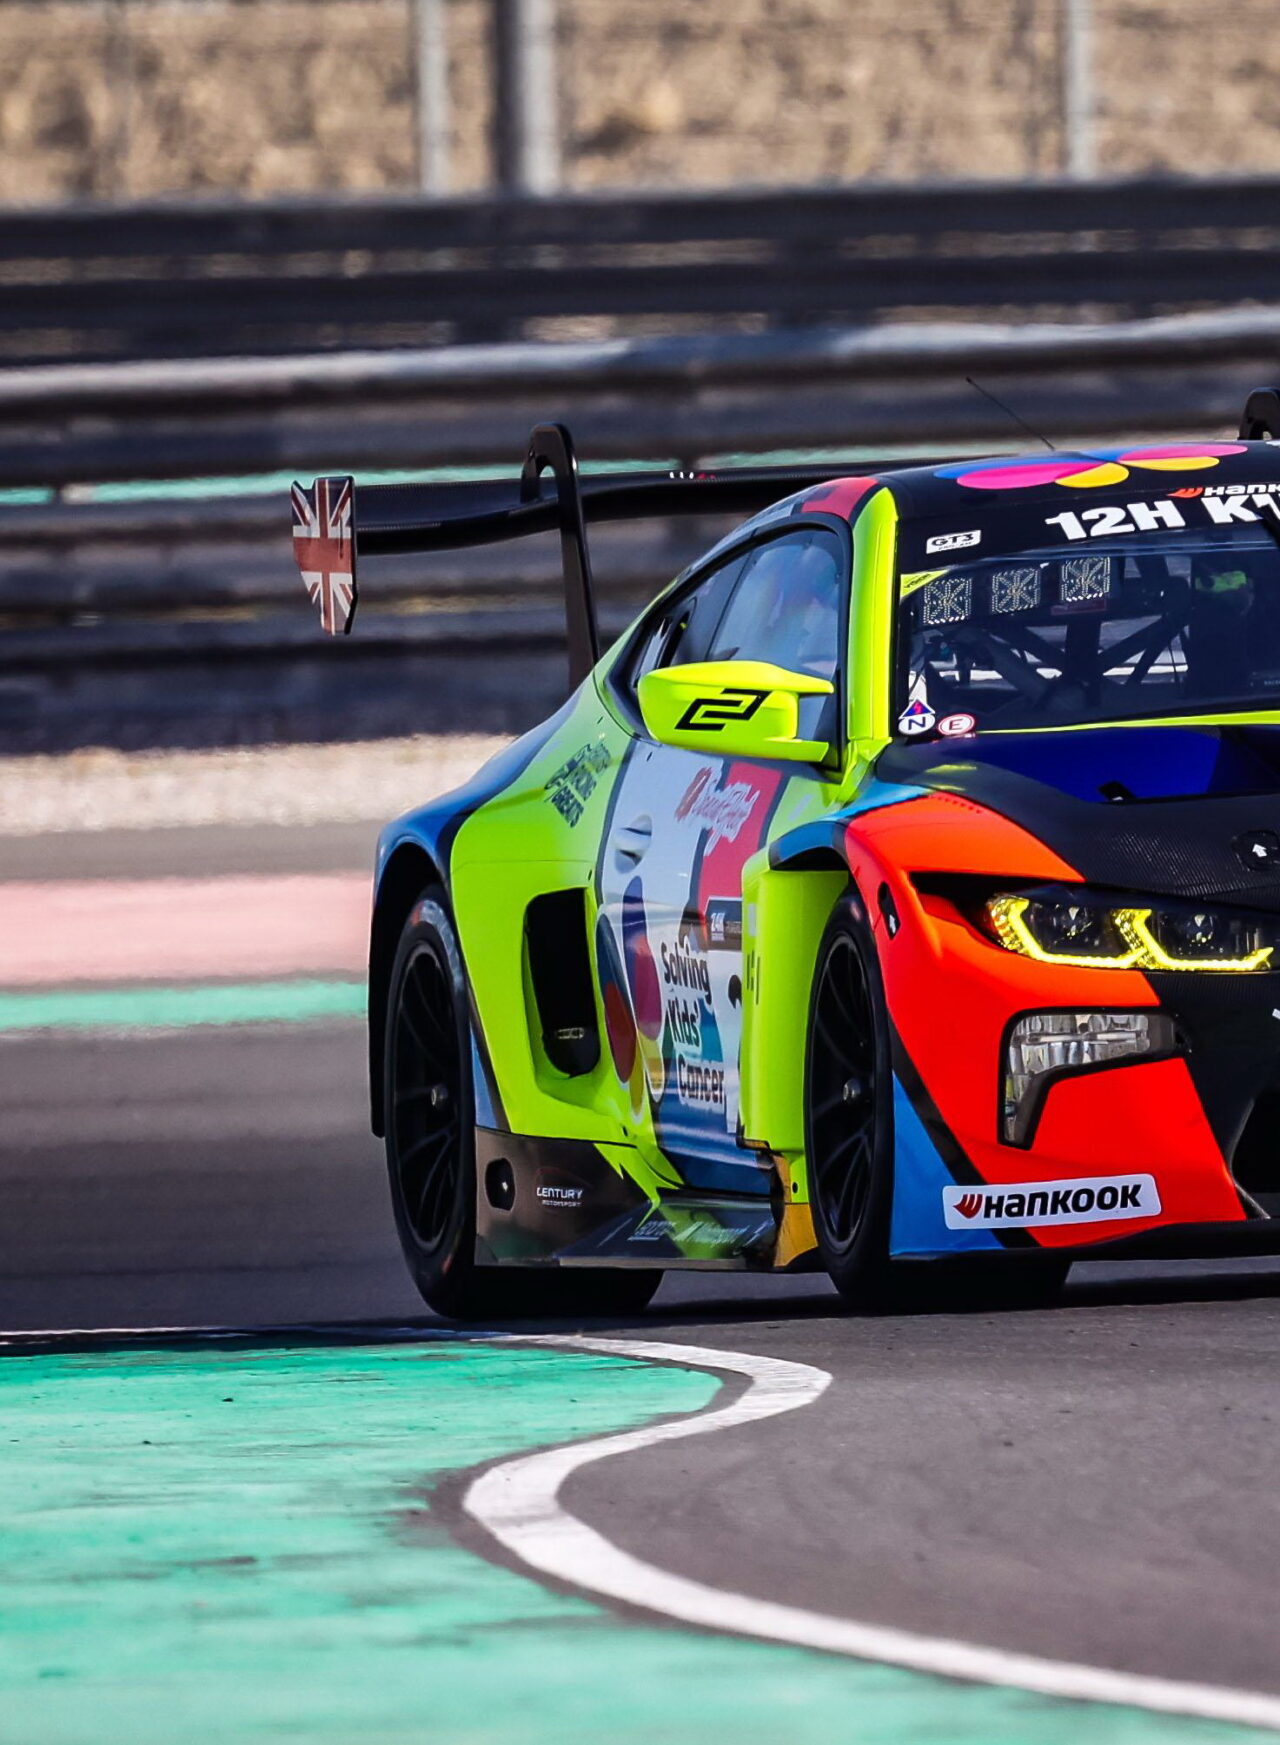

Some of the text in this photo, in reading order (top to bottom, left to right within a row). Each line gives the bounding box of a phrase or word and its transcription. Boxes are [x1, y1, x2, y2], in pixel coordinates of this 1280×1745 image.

[1044, 499, 1187, 541] 12H
[931, 532, 976, 547] GT3
[907, 716, 926, 732] N
[949, 718, 965, 731] E
[660, 941, 713, 1005] Solving
[677, 1053, 725, 1105] Cancer
[536, 1186, 583, 1199] CENTURY
